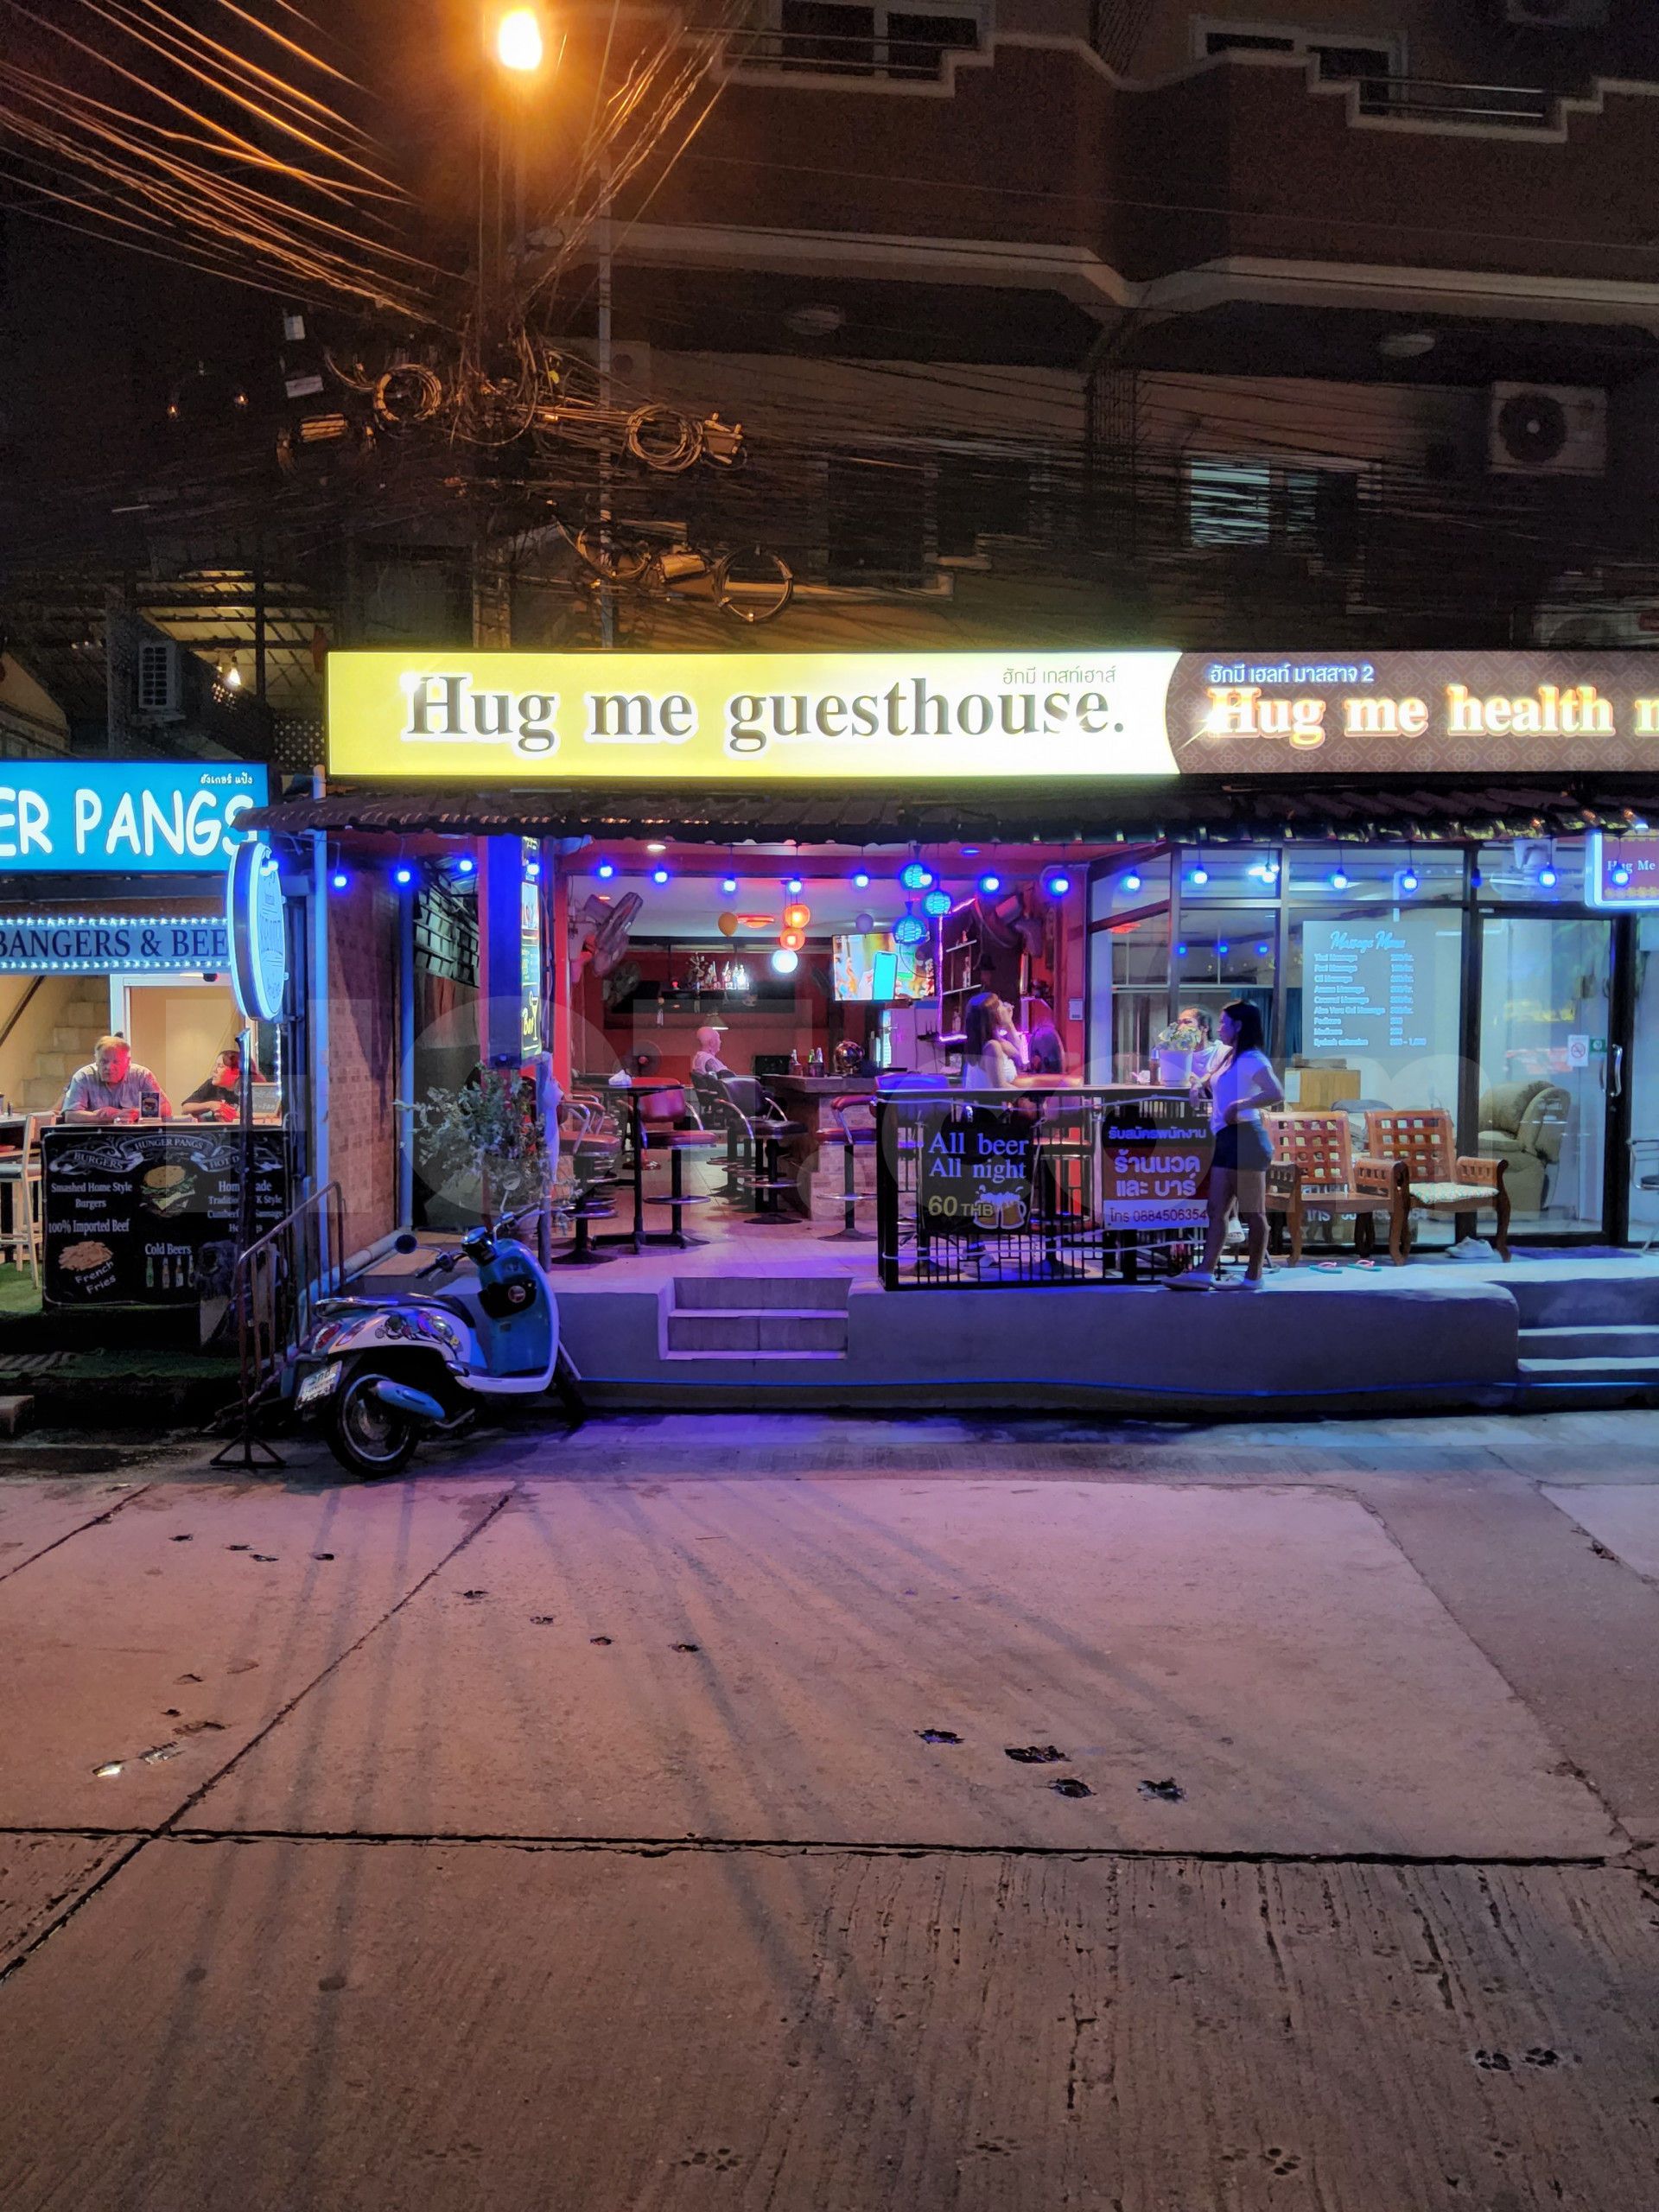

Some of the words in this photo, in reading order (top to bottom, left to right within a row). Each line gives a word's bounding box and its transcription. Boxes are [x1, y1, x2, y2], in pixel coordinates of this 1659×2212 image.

[1362, 664, 1374, 682] 2
[408, 676, 555, 753] Hug
[589, 693, 693, 736] me
[728, 677, 1124, 753] guesthouse.
[1209, 687, 1326, 749] Hug
[1344, 696, 1428, 737] me
[1447, 683, 1616, 736] health
[75, 788, 256, 857] PANGS
[1637, 860, 1656, 871] Me
[140, 928, 163, 957] &
[170, 928, 228, 957] BEE
[134, 1137, 172, 1150] HUNGER
[174, 1138, 204, 1150] PANGS
[928, 1132, 966, 1154] All
[977, 1133, 1029, 1155] beer
[73, 1152, 124, 1169] BURGERS
[929, 1158, 962, 1178] All
[973, 1158, 1027, 1184] night
[1115, 1148, 1200, 1173] ร้านนวด
[51, 1182, 86, 1193] Smashed
[87, 1183, 111, 1192] Home
[112, 1181, 132, 1194] Style
[1116, 1180, 1148, 1197] และ
[1154, 1173, 1197, 1197] บาร์
[75, 1198, 107, 1211] Burgers
[928, 1195, 958, 1217] 60
[961, 1203, 994, 1217] THB
[48, 1219, 71, 1233] 100%
[73, 1219, 111, 1236] Imported
[111, 1218, 130, 1233] Beef
[144, 1243, 165, 1255] Cold
[167, 1243, 193, 1255] Beers
[74, 1261, 114, 1284] French
[86, 1274, 117, 1295] Fries
